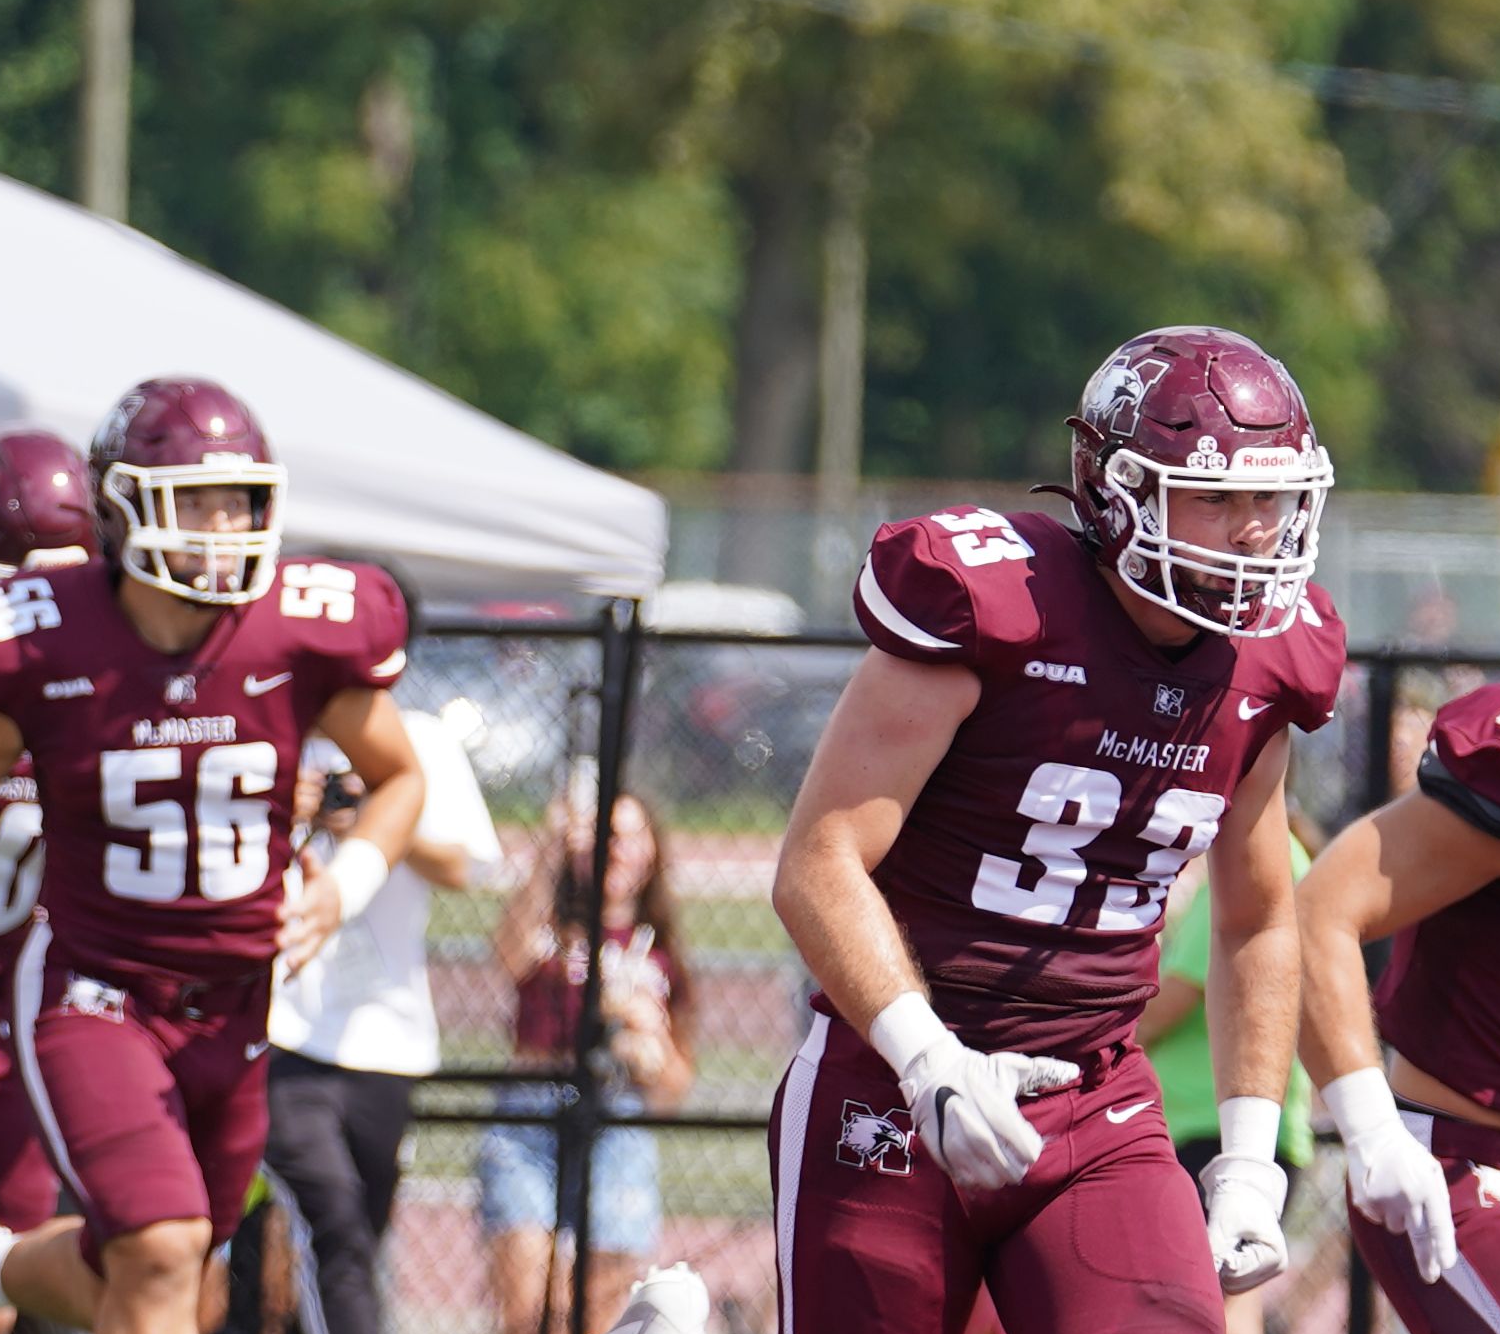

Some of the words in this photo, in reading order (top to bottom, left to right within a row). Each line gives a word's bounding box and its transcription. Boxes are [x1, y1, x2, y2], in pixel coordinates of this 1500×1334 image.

[1243, 455, 1295, 467] Riddell
[1023, 659, 1088, 686] OUA
[132, 714, 237, 746] McMASTER
[1096, 728, 1211, 774] McMASTER
[101, 740, 279, 903] 56
[970, 761, 1227, 932] 33
